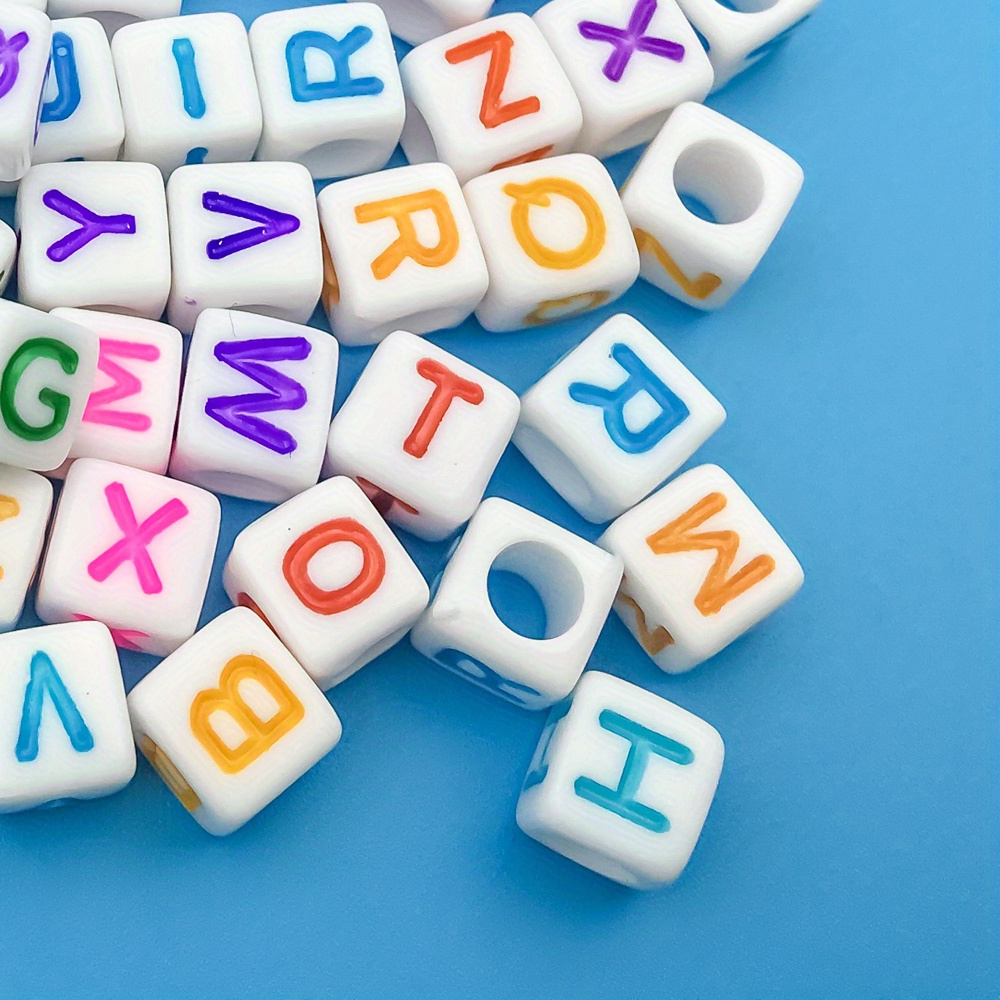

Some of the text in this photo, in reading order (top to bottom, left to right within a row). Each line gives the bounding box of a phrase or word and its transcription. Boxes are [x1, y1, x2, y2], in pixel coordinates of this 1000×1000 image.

[172, 38, 206, 119] I
[285, 25, 384, 103] R
[43, 189, 136, 262] Y
[202, 191, 300, 260] V
[354, 189, 459, 280] R
[501, 177, 606, 270] Q
[0, 338, 78, 441] G
[403, 359, 484, 458] T
[568, 343, 690, 454] R
[88, 482, 189, 595] X
[282, 518, 386, 615] O
[189, 654, 305, 775] B
[574, 709, 694, 833] H
